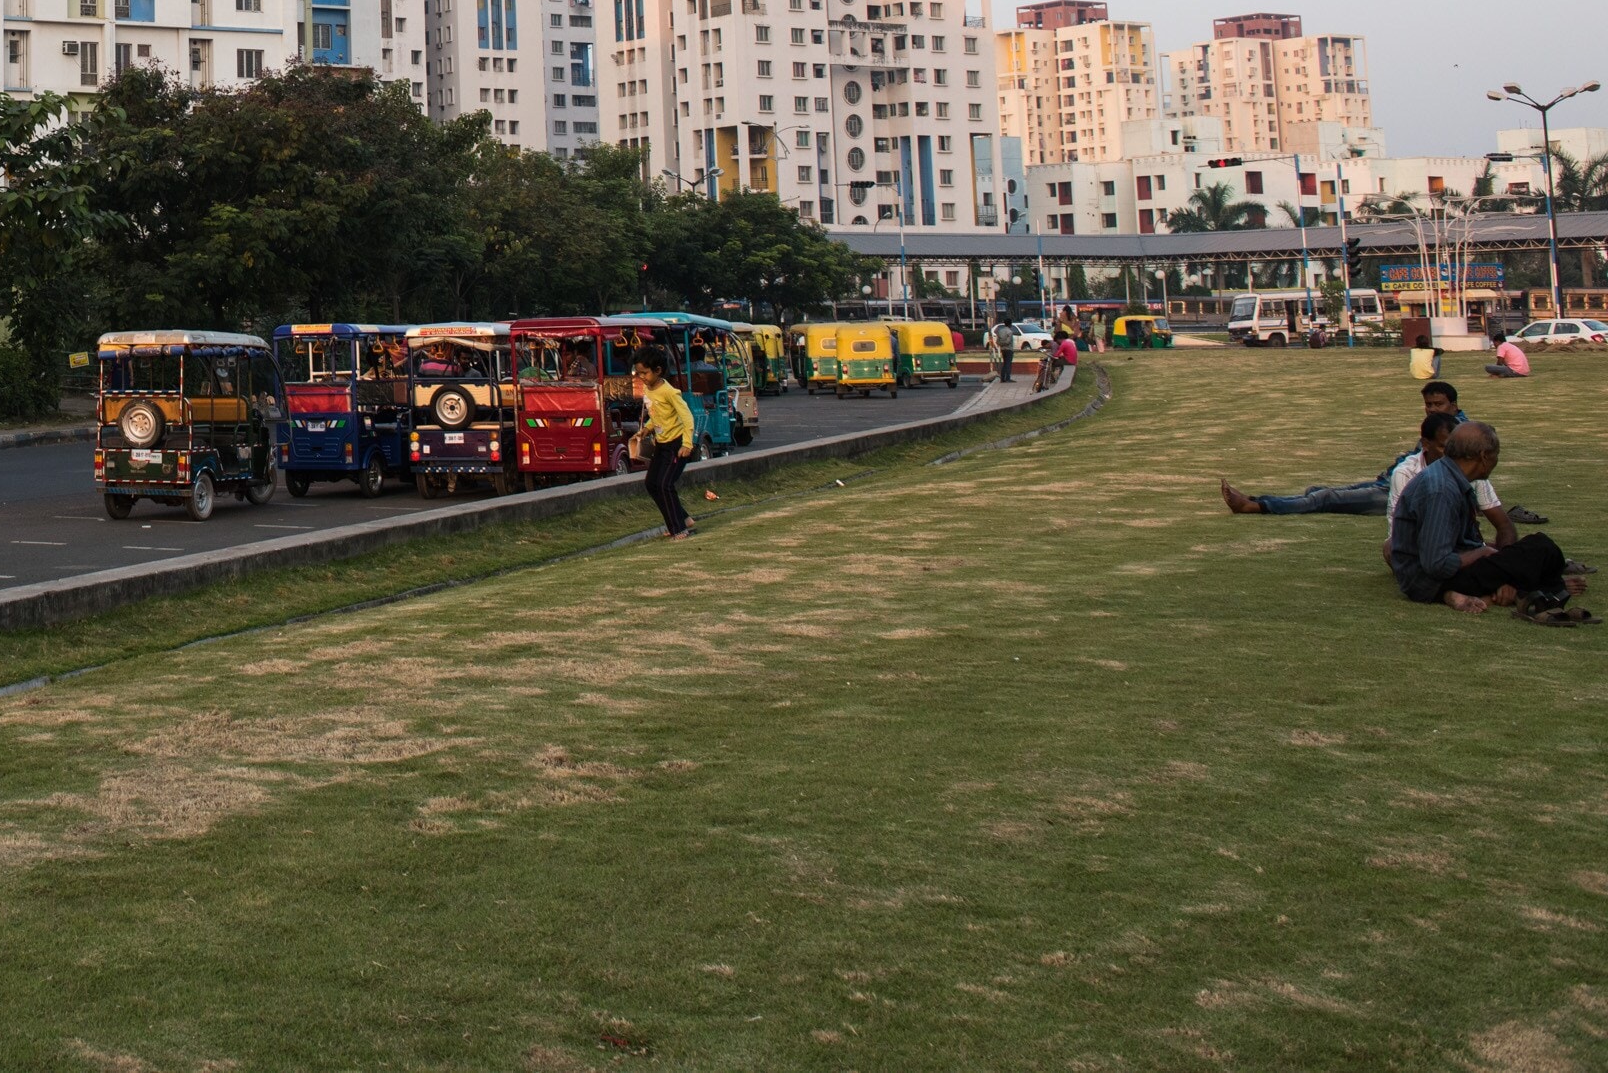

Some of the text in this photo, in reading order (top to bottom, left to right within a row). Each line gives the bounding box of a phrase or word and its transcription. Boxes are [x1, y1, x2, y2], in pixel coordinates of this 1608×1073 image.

[1389, 267, 1409, 281] CAFE
[1474, 266, 1497, 279] COFFEE
[1393, 282, 1411, 290] CAFE
